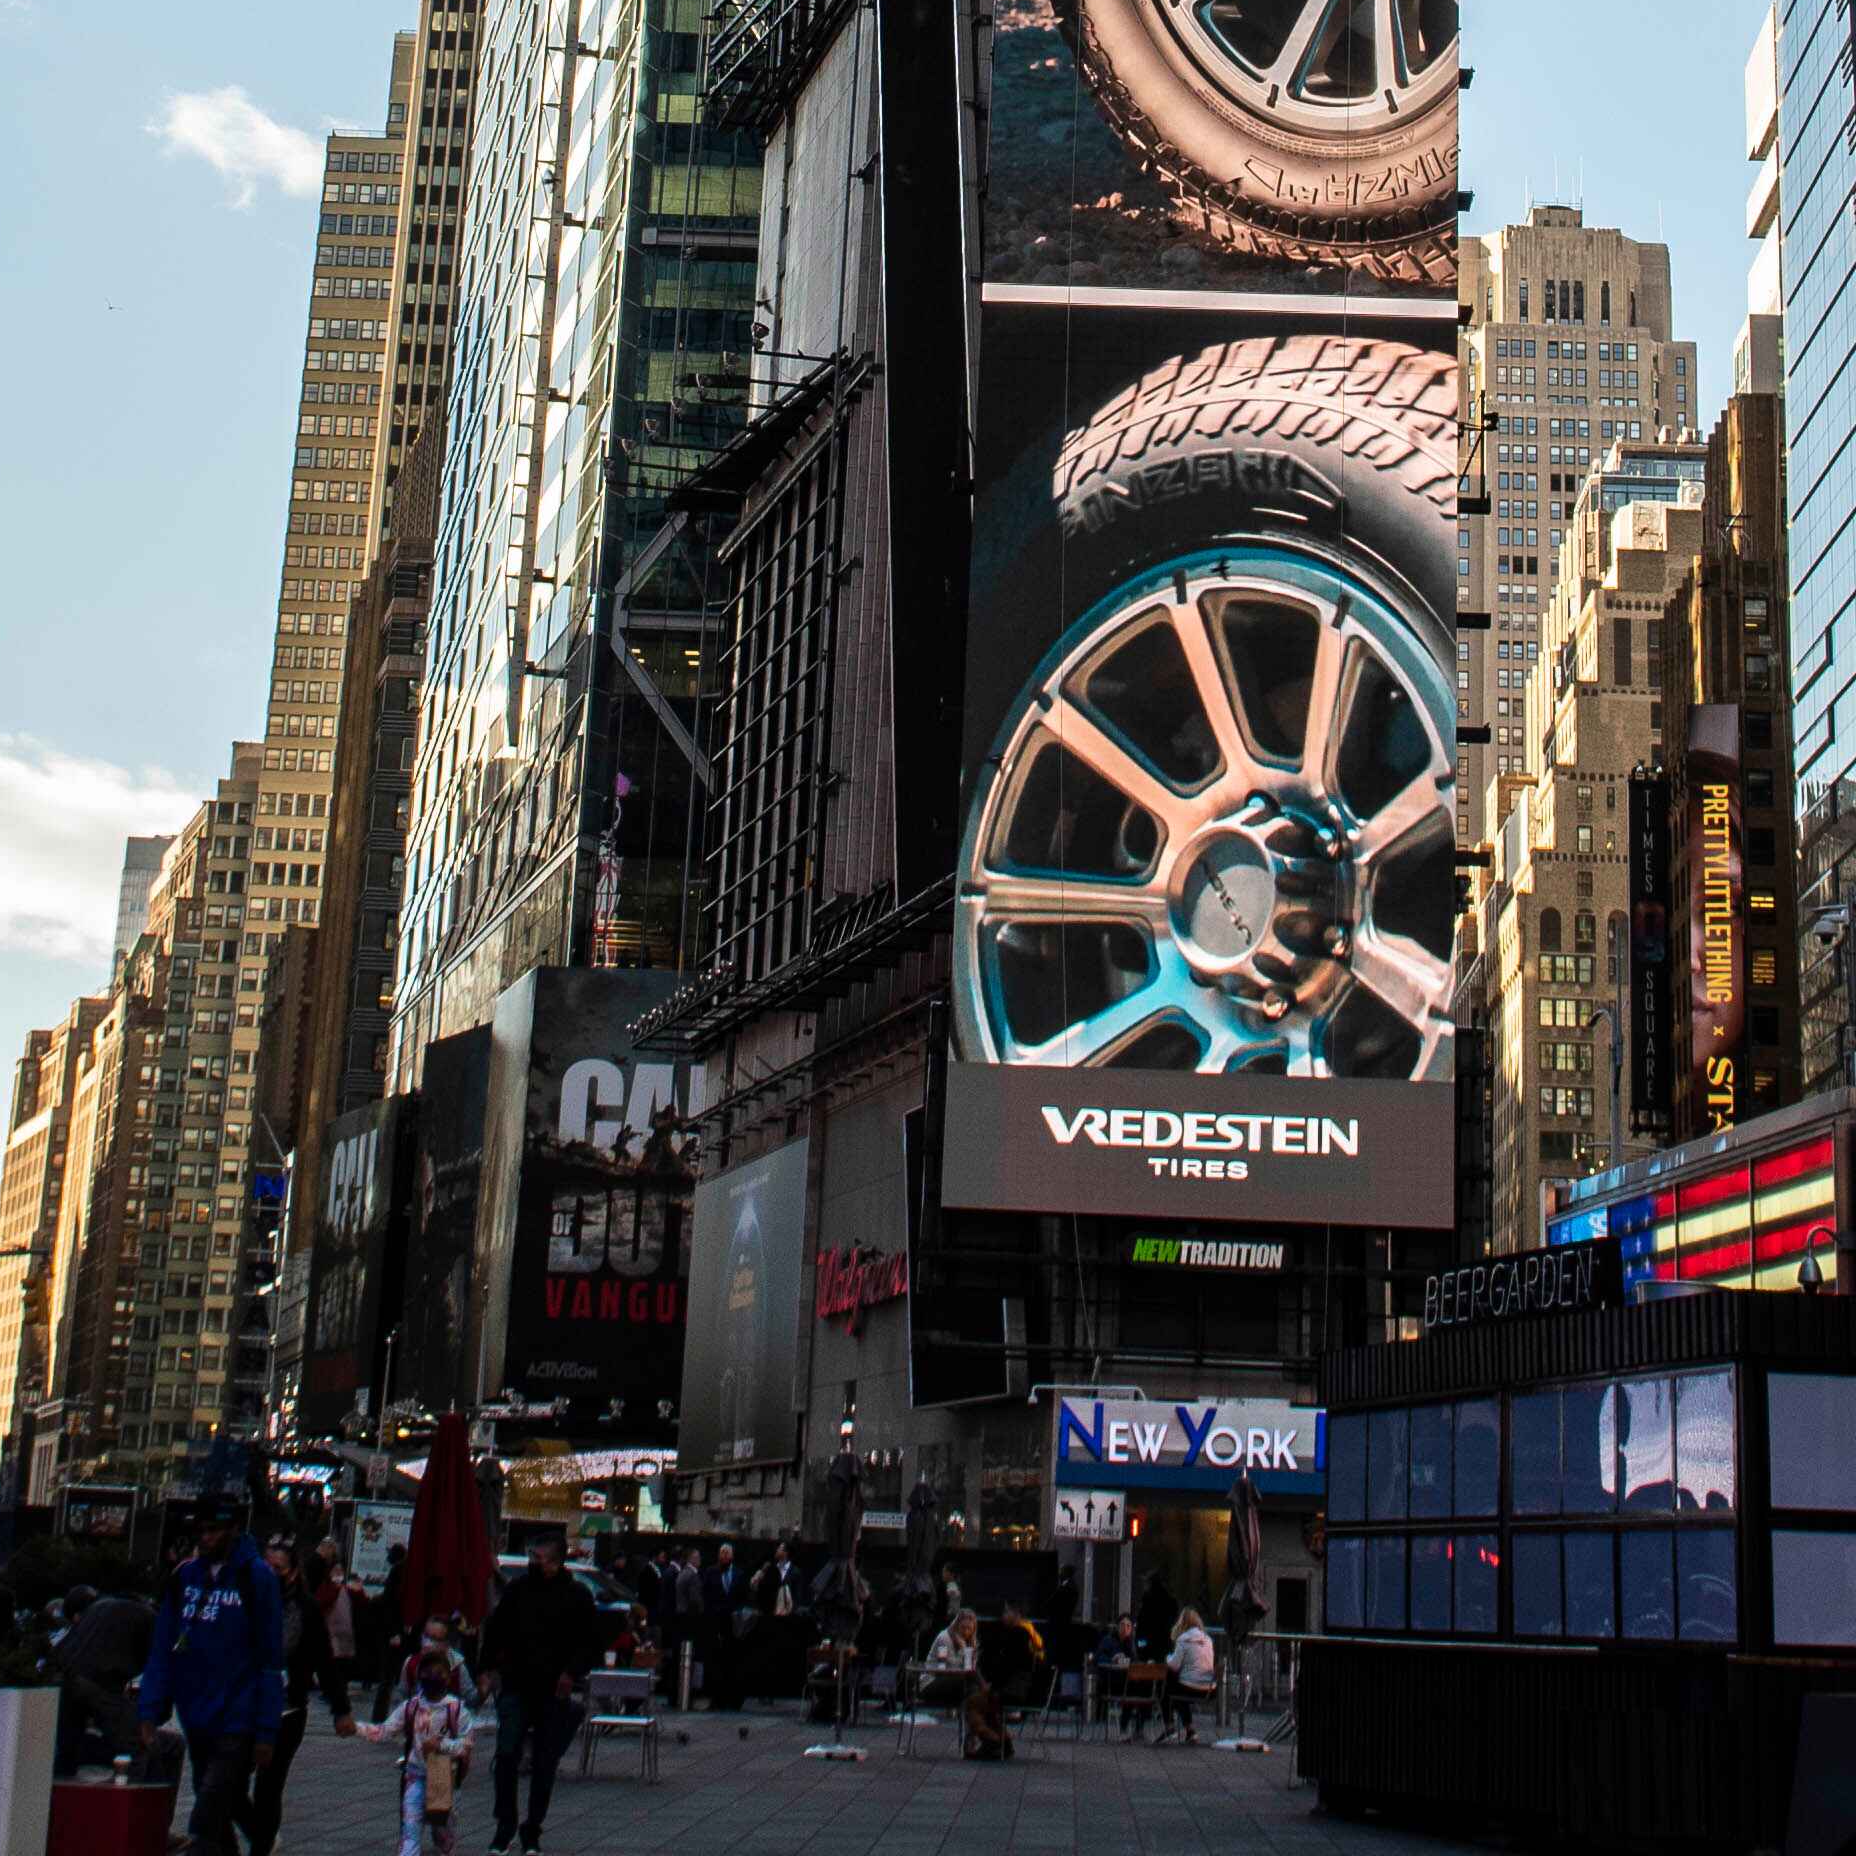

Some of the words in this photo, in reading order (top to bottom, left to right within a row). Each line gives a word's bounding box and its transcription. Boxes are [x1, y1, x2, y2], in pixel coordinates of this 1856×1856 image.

[1643, 789, 1655, 893] TIMES
[1702, 784, 1734, 1004] PRETTYLITTLETHING
[1645, 970, 1656, 1101] SQUARE
[558, 1057, 706, 1169] CA
[1041, 1106, 1359, 1156] VREDESTEIN
[1147, 1157, 1249, 1180] TIRES
[1424, 1266, 1487, 1328] BEER
[1489, 1247, 1593, 1317] GARDEN
[526, 1361, 598, 1383] ACTIVISION
[1058, 1402, 1168, 1463] NEW
[1175, 1405, 1298, 1472] YORK
